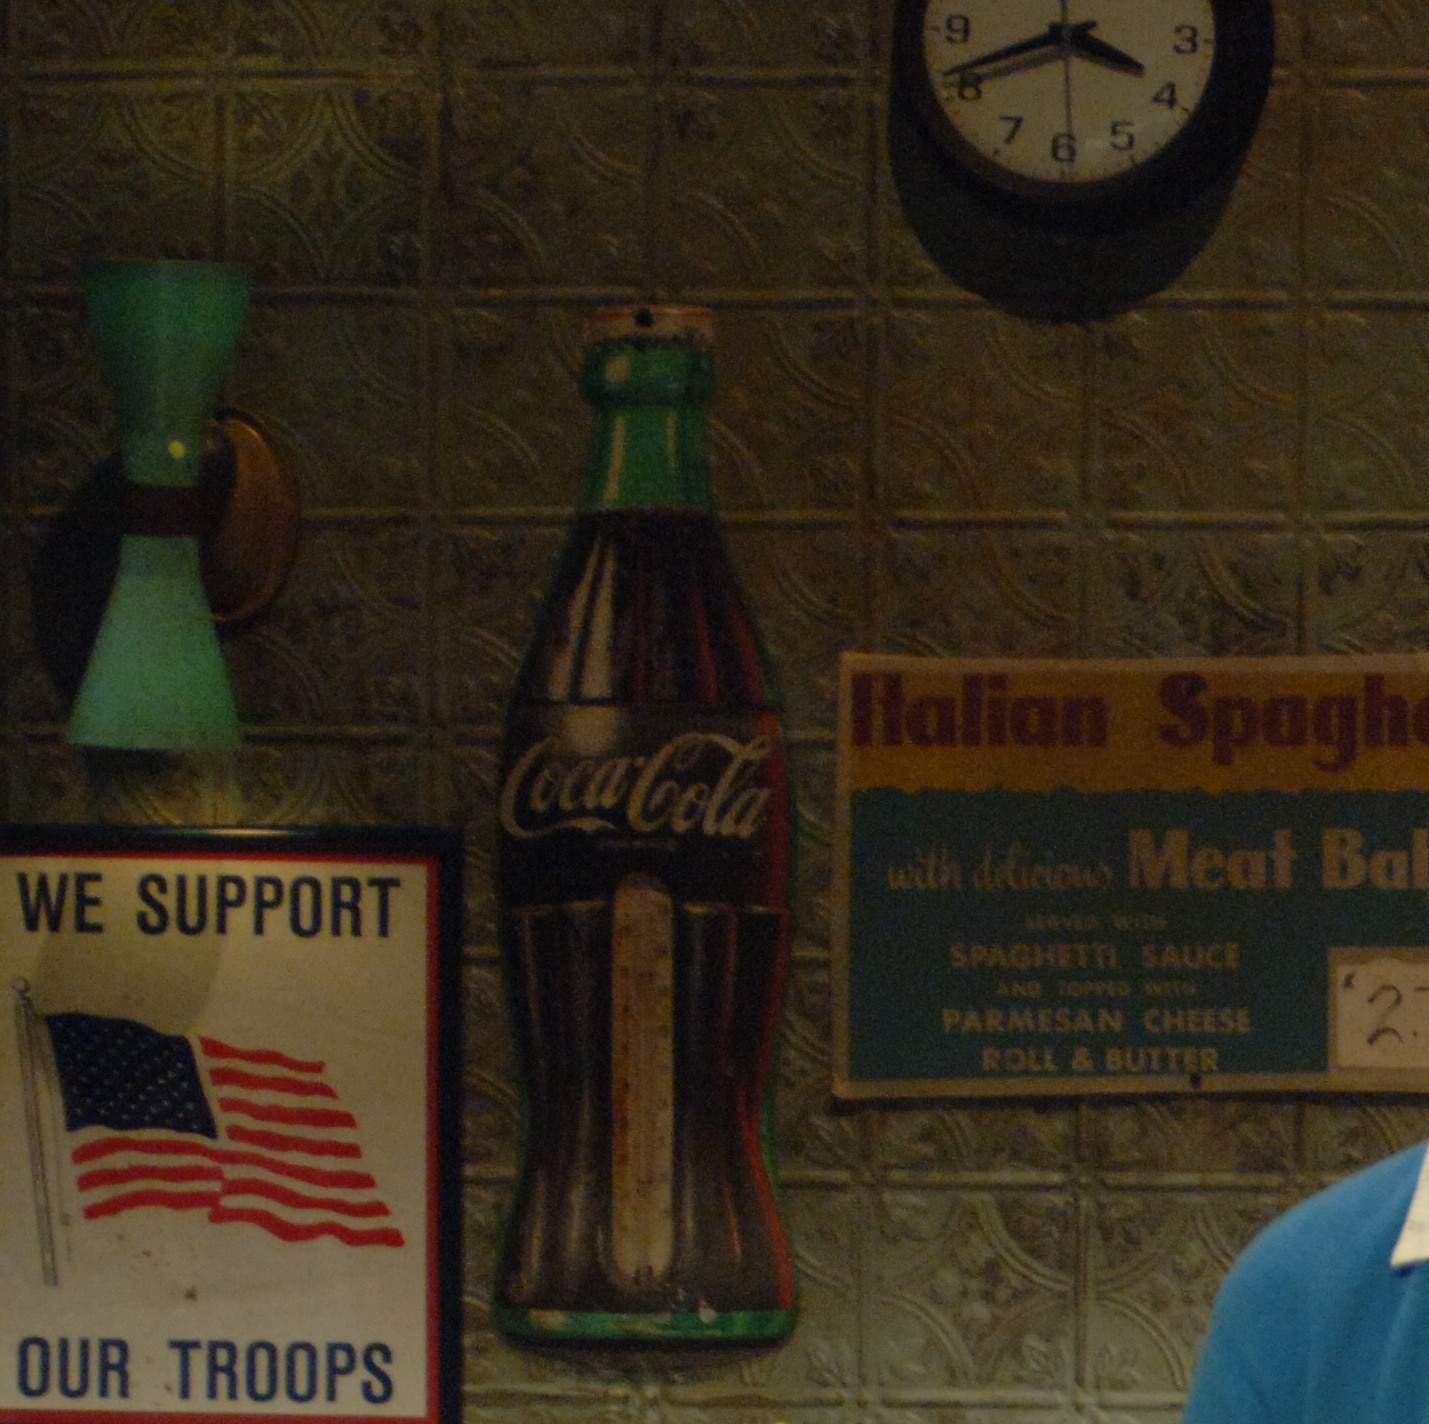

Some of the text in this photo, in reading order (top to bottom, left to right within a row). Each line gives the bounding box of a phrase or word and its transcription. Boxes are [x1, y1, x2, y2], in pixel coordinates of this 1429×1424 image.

[945, 14, 971, 44] 9
[1173, 24, 1199, 54] 3
[1153, 81, 1177, 109] 4
[1000, 115, 1024, 145] 7
[1110, 120, 1135, 151] 5
[1051, 132, 1076, 163] 6
[850, 671, 1111, 749] Italian
[887, 848, 964, 891] with
[1128, 826, 1301, 891] Meat
[16, 872, 401, 938] WE SUPPORT
[950, 943, 1239, 969] SPAGHETTI SAUCE
[941, 1007, 1251, 1034] PARMESAN CHEESE
[982, 1047, 1218, 1073] ROLL & BUTTER
[16, 1335, 394, 1404] OUR TROOPS
